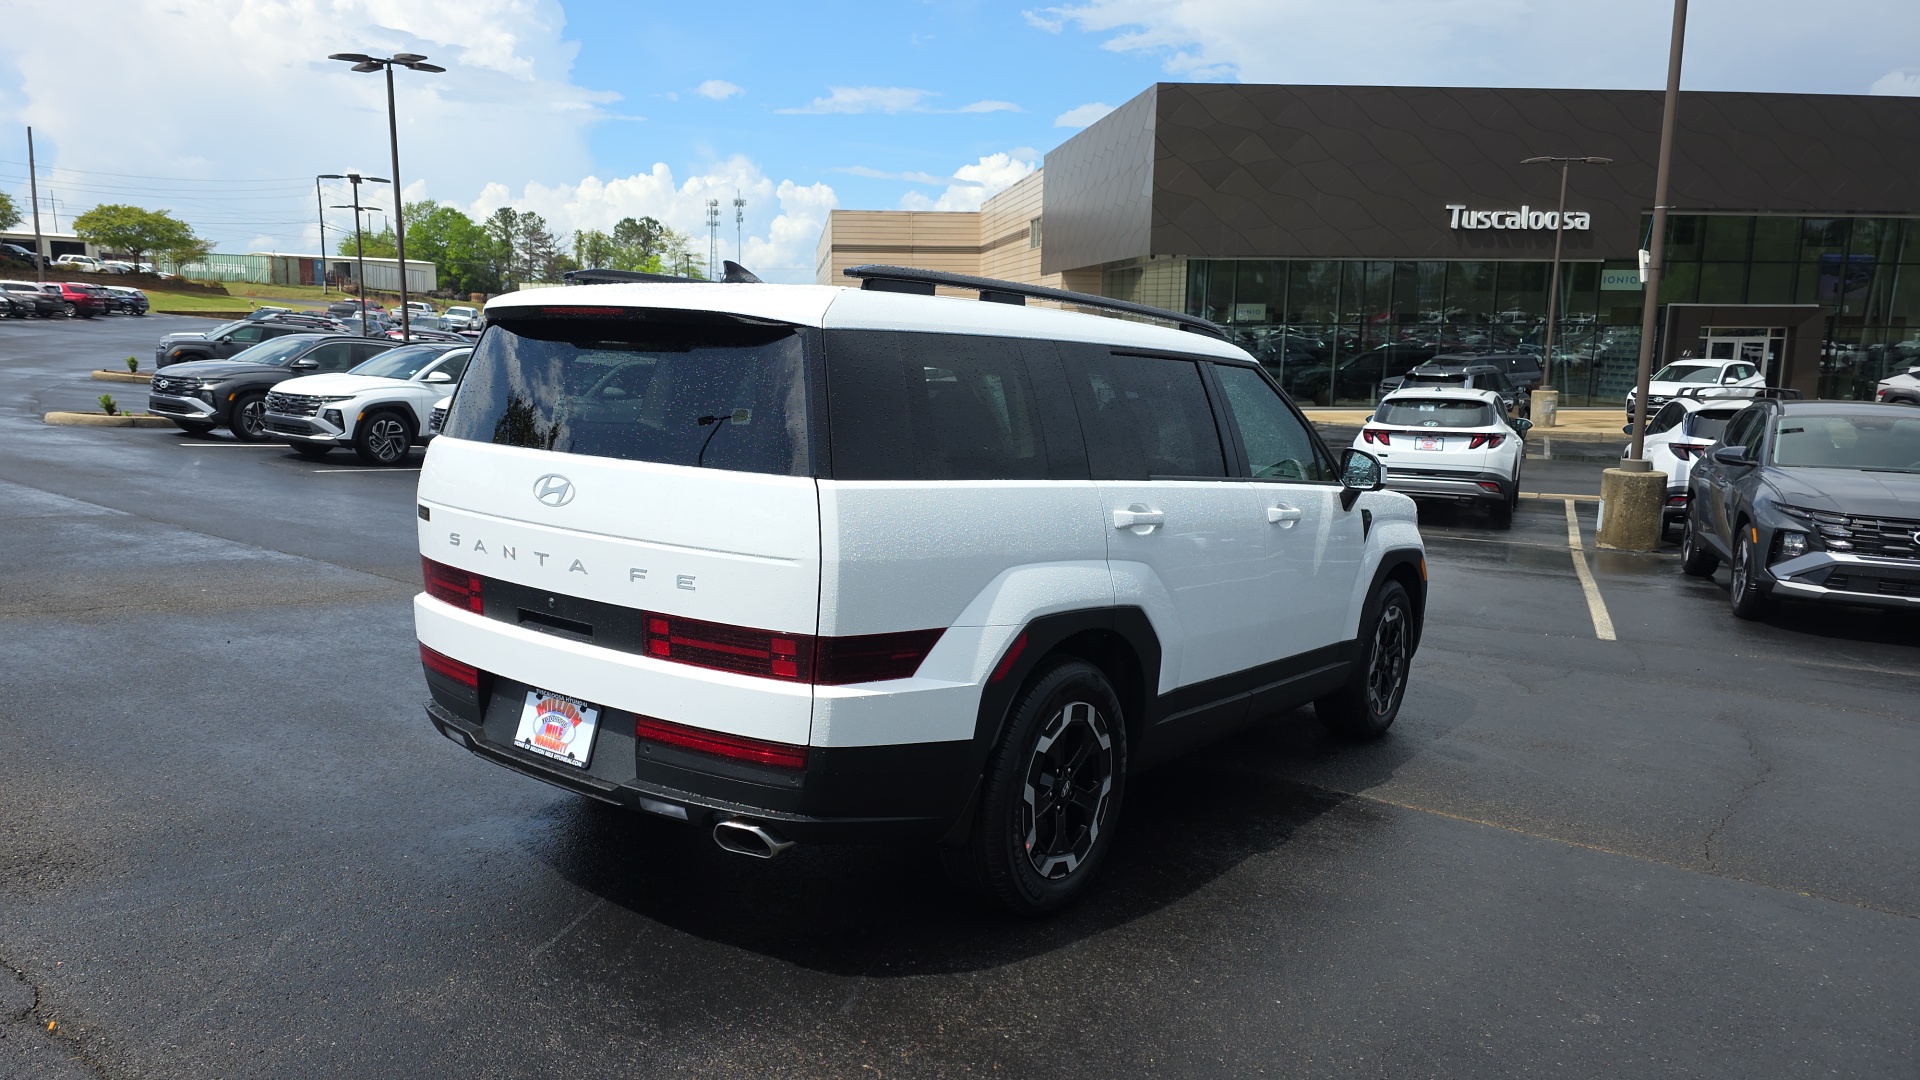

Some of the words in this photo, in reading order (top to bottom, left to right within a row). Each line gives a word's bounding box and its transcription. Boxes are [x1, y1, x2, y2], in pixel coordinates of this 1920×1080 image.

[1446, 204, 1591, 230] Tuscaloosa
[211, 262, 246, 274] SHIPPING
[1603, 275, 1638, 285] IONIQ
[449, 532, 589, 576] SANTA
[629, 567, 696, 593] FE
[566, 695, 588, 708] HYUNDAI
[536, 697, 583, 728] MILLION
[545, 723, 564, 740] MILE
[534, 734, 568, 753] WARRANTY
